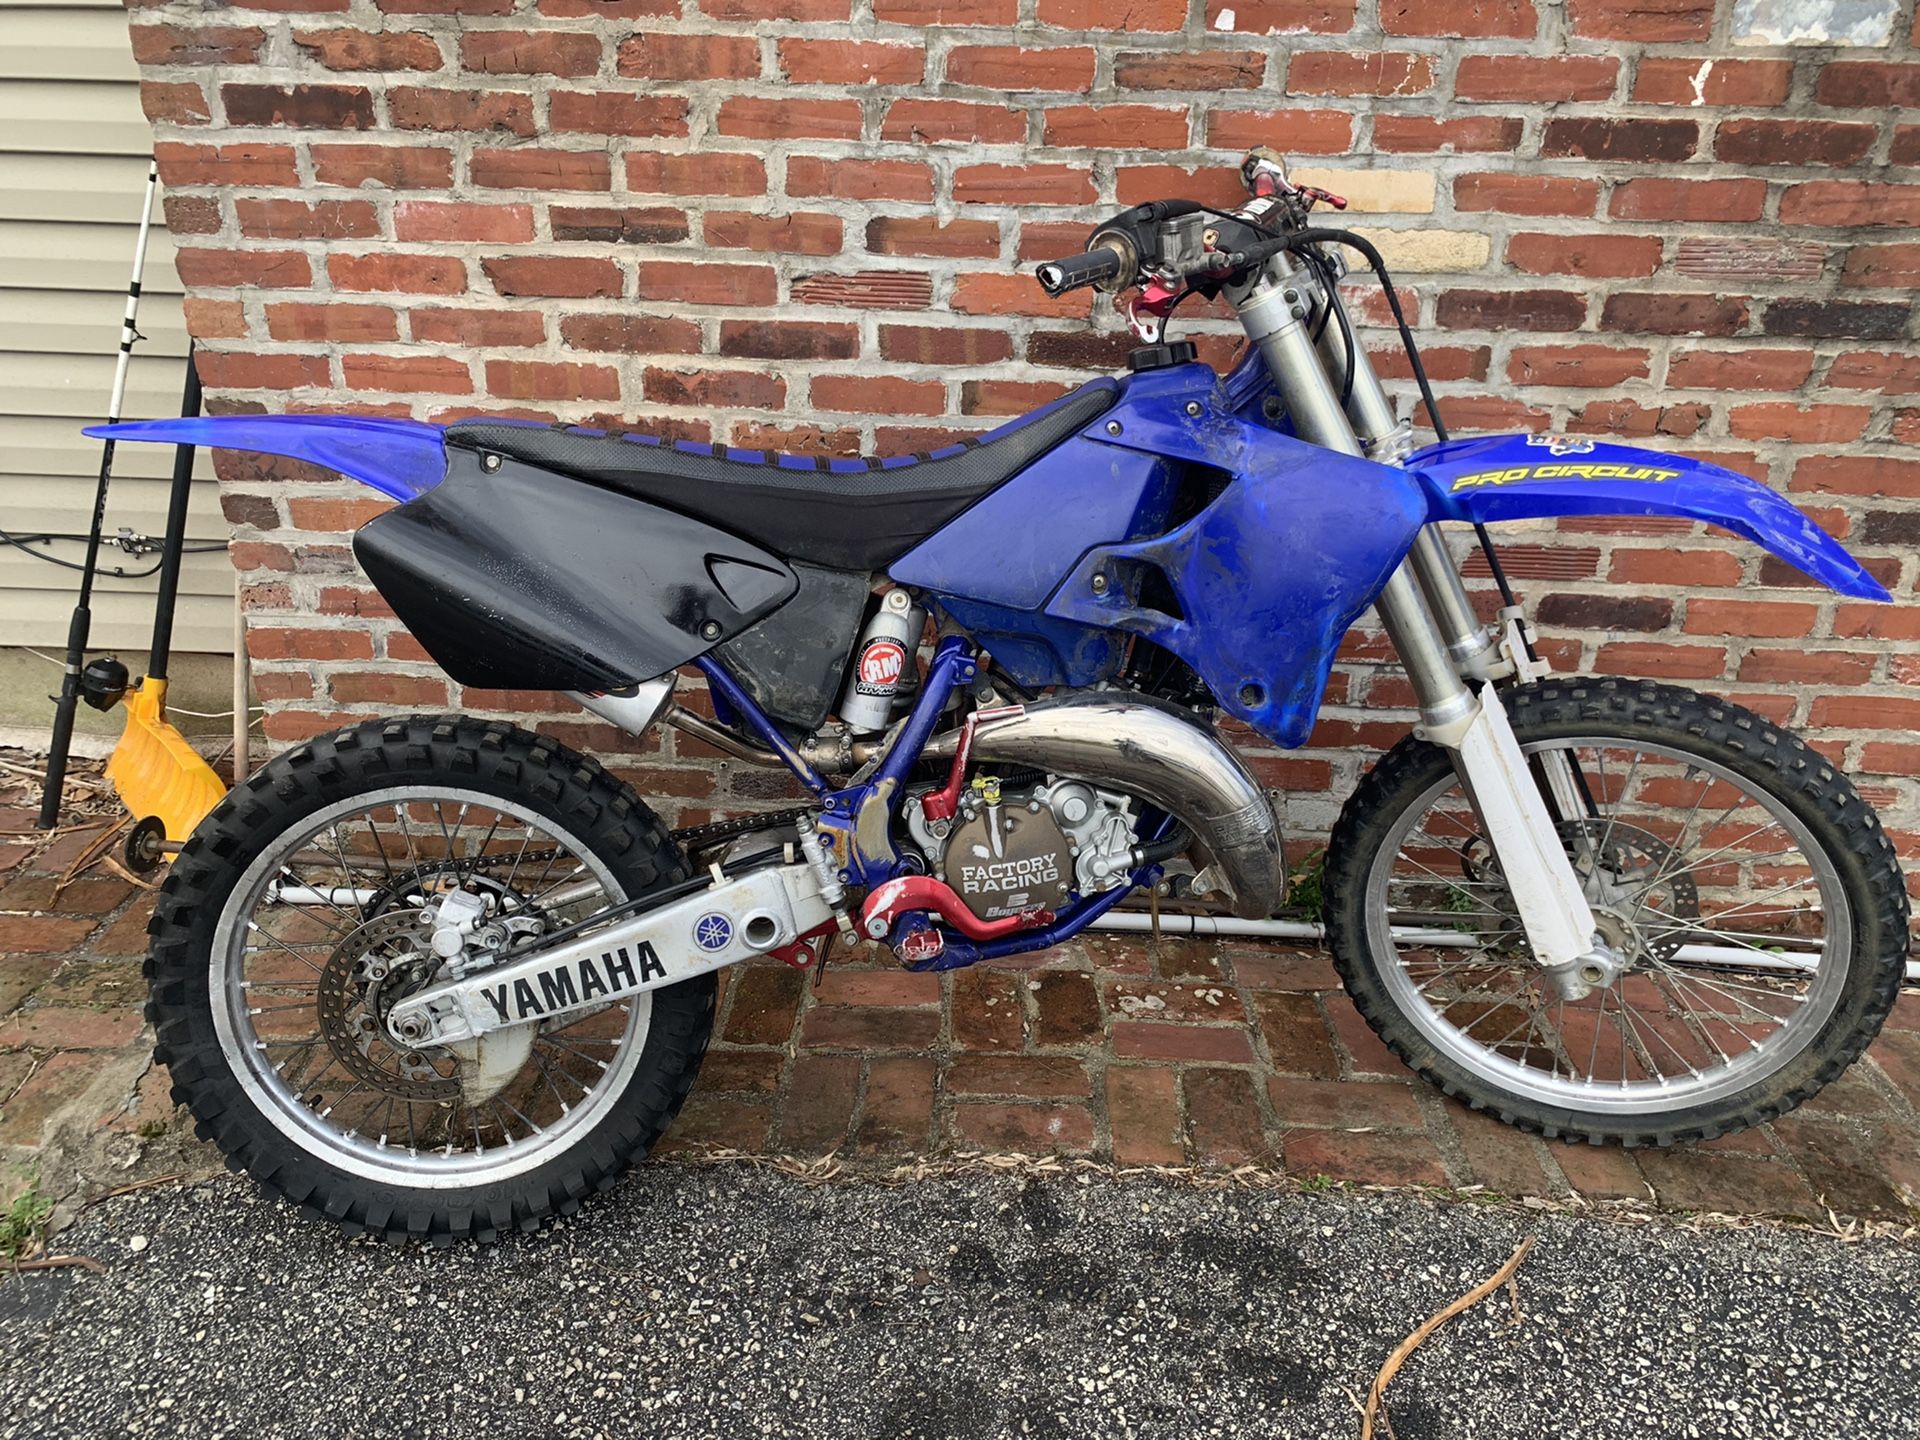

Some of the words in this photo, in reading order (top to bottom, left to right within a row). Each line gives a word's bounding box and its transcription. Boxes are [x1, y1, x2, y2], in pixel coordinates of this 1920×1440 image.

[1452, 467, 1530, 491] PRO
[1532, 465, 1679, 482] CIRCUIT
[961, 852, 1057, 881] FACTORY
[963, 867, 1059, 894] RACING
[480, 939, 668, 1024] YAMAHA
